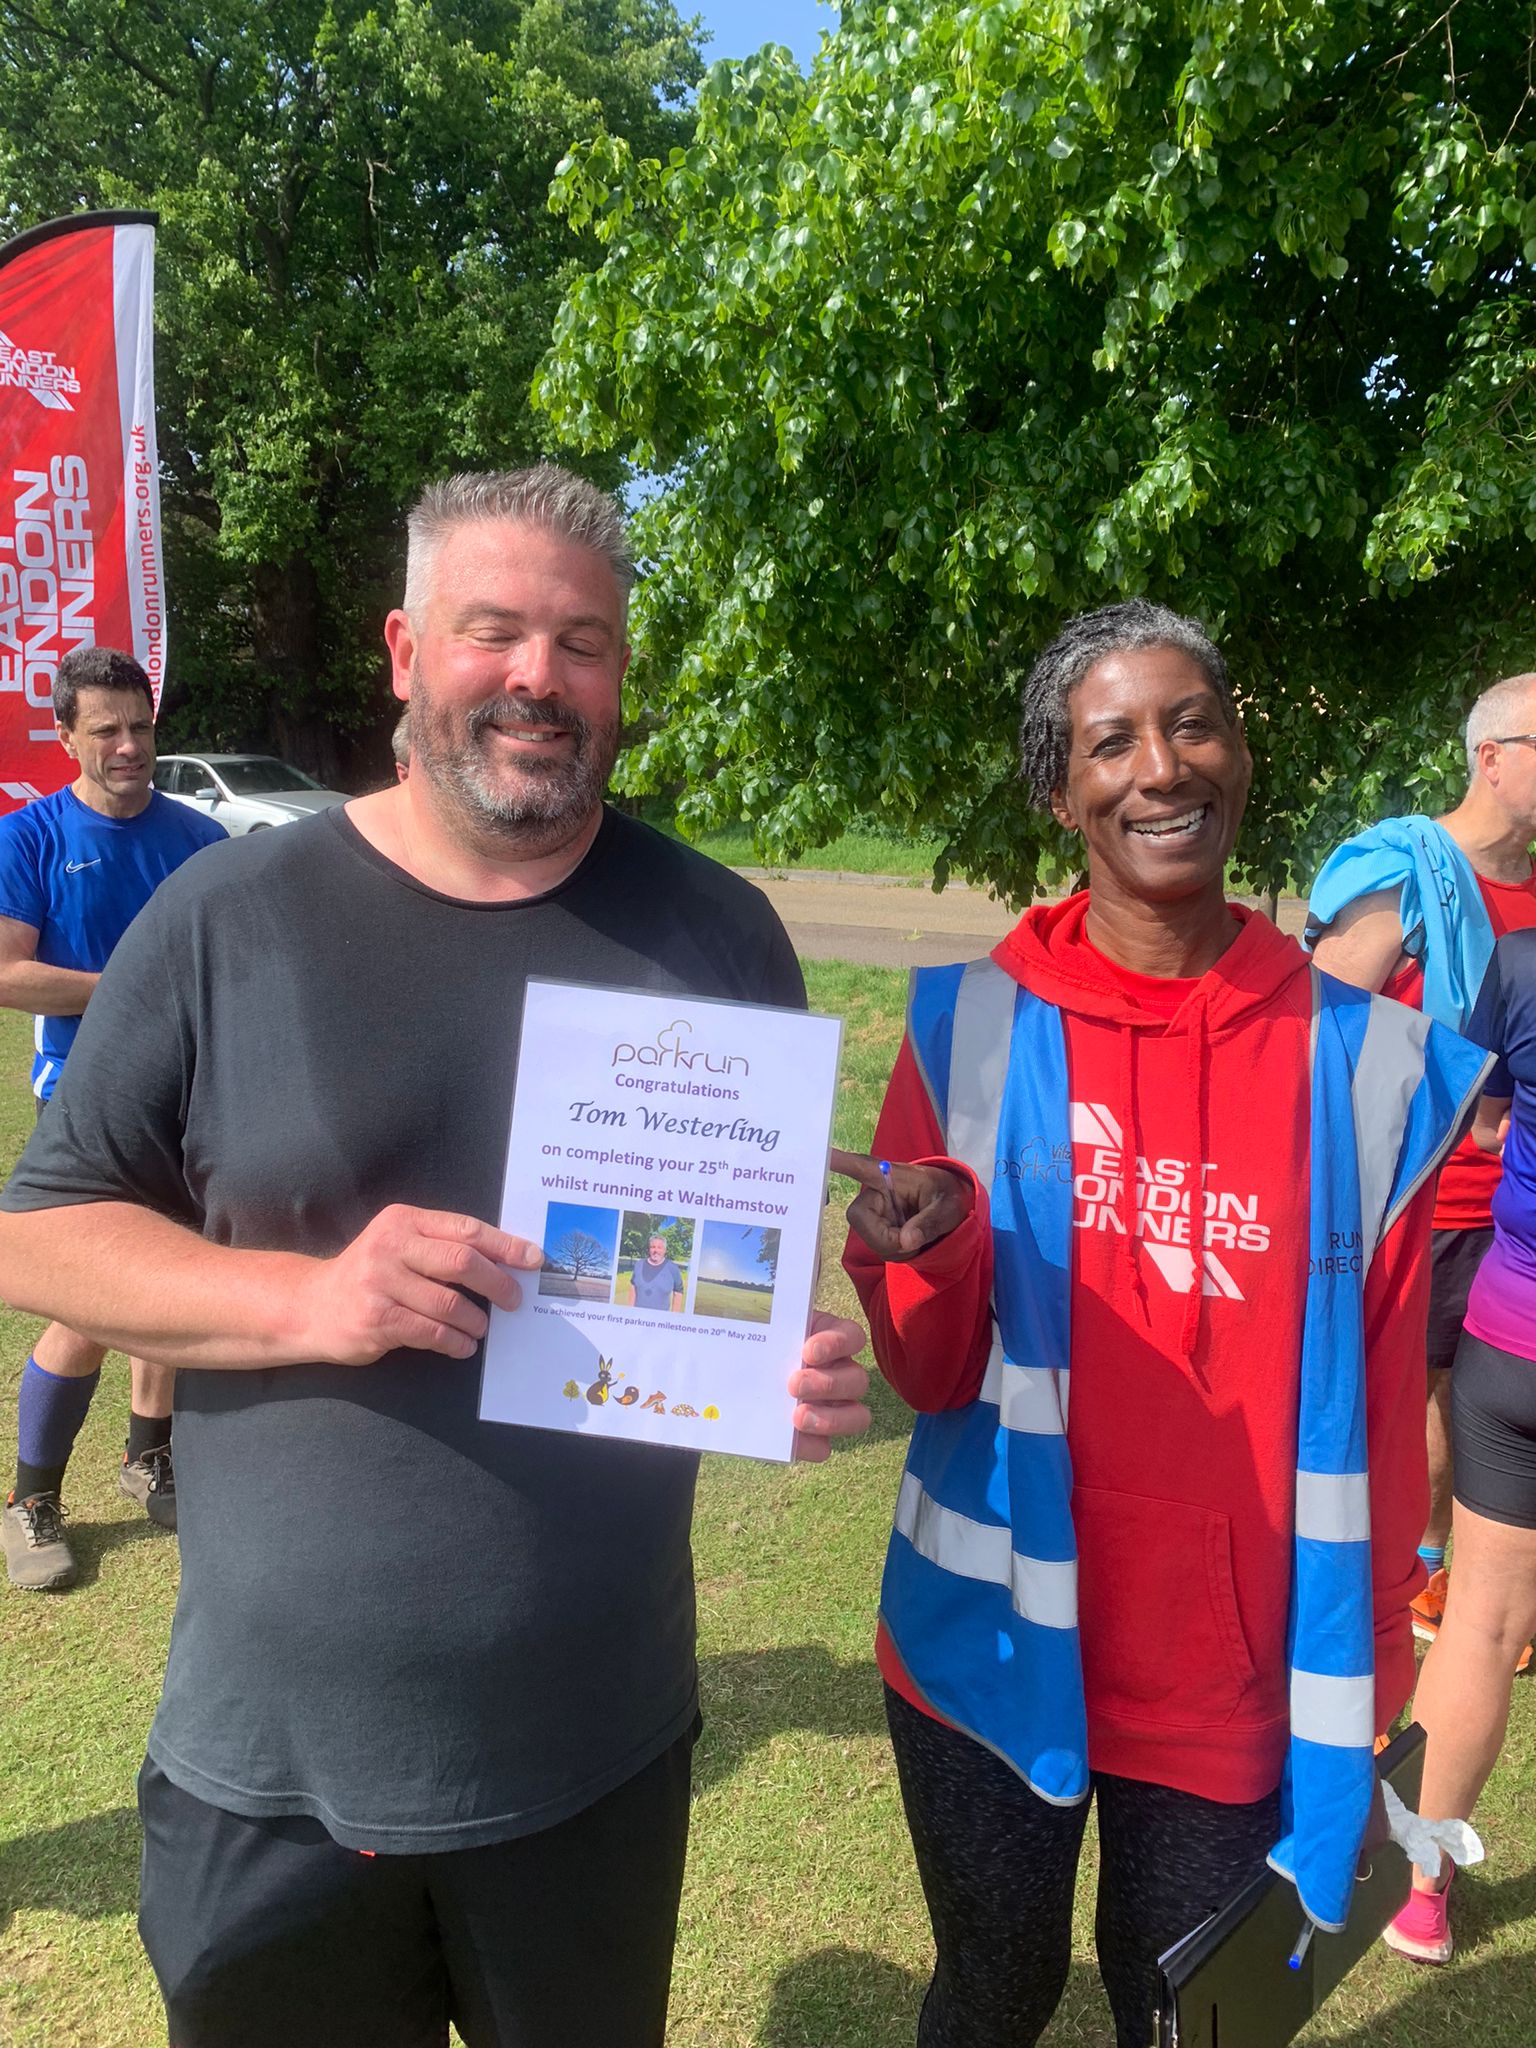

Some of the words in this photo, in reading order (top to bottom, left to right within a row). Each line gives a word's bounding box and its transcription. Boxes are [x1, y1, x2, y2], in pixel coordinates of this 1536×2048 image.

[0, 347, 56, 365] EAST
[612, 1034, 749, 1077] parkrun
[615, 1073, 740, 1101] Congratulations
[569, 1101, 627, 1127] Tom
[636, 1106, 781, 1151] Westerling
[542, 1144, 561, 1156] on
[566, 1149, 654, 1170] completing
[658, 1157, 695, 1172] your
[732, 1166, 795, 1184] parkrun
[541, 1174, 588, 1192] whilst
[593, 1183, 654, 1202] running
[657, 1189, 673, 1201] at
[678, 1189, 789, 1215] Walthamstow
[533, 1305, 549, 1315] You
[550, 1308, 585, 1319] achieved
[587, 1311, 605, 1322] your
[607, 1314, 623, 1324] first
[624, 1318, 656, 1329] parkrun
[657, 1321, 697, 1334] milestone
[698, 1327, 709, 1335] on
[727, 1330, 746, 1341] May
[747, 1333, 766, 1343] 2023
